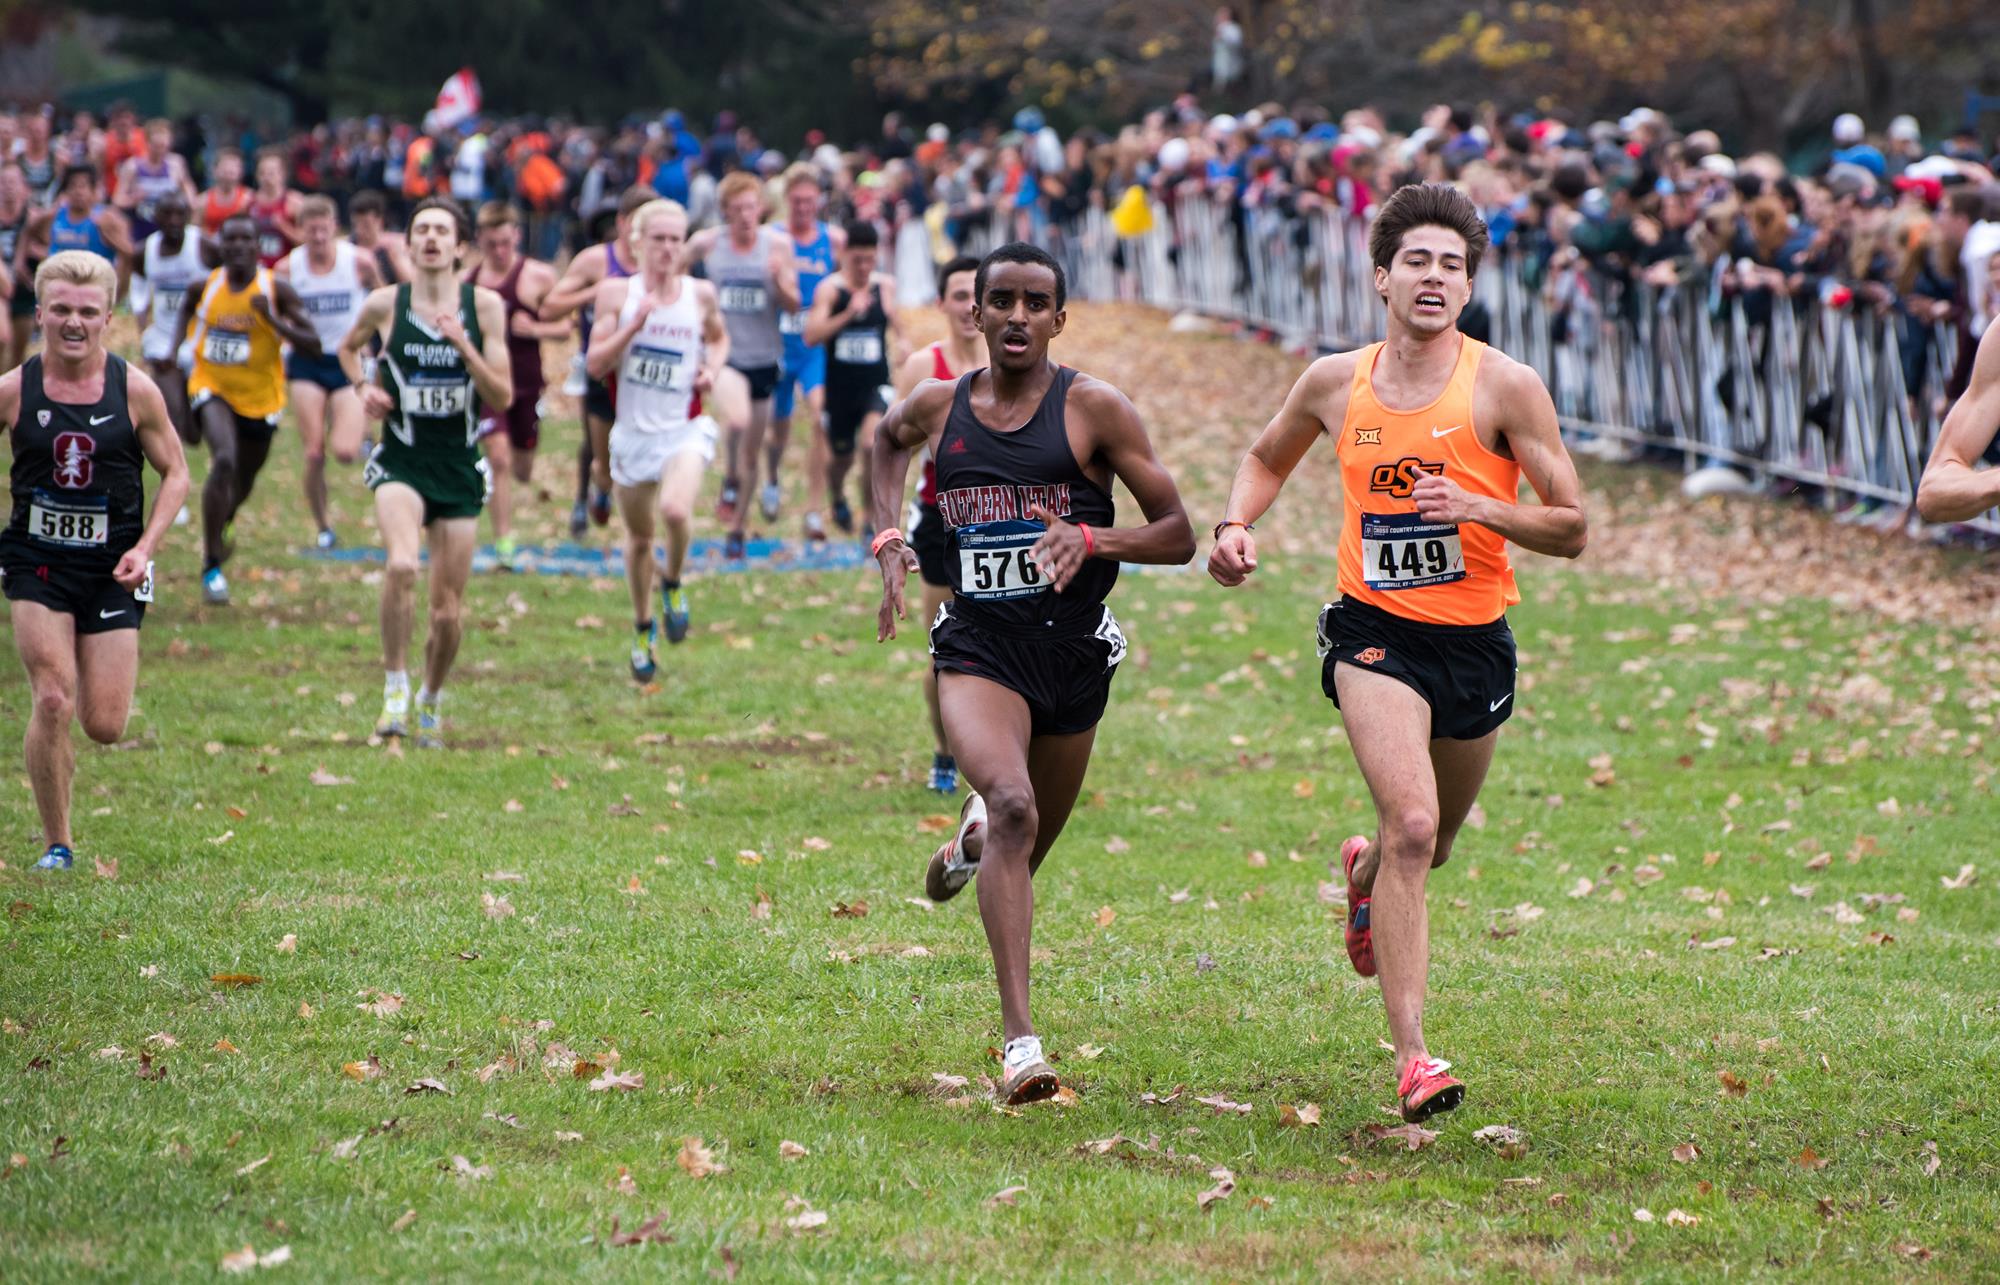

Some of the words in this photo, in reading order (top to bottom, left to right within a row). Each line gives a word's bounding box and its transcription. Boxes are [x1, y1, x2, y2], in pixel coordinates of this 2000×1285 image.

[404, 343, 461, 357] COLORA
[418, 354, 456, 368] STATE
[418, 388, 457, 411] 165
[1370, 457, 1444, 498] OS
[936, 485, 1018, 527] SOUTHERN
[1018, 483, 1071, 520] UTAH
[41, 510, 94, 539] 588
[1390, 526, 1413, 534] COUNTRY
[1413, 523, 1456, 533] CHAMPIONSHIPS
[984, 535, 1005, 543] COUNTRY
[973, 549, 1040, 589] 576
[1379, 540, 1447, 578] 449
